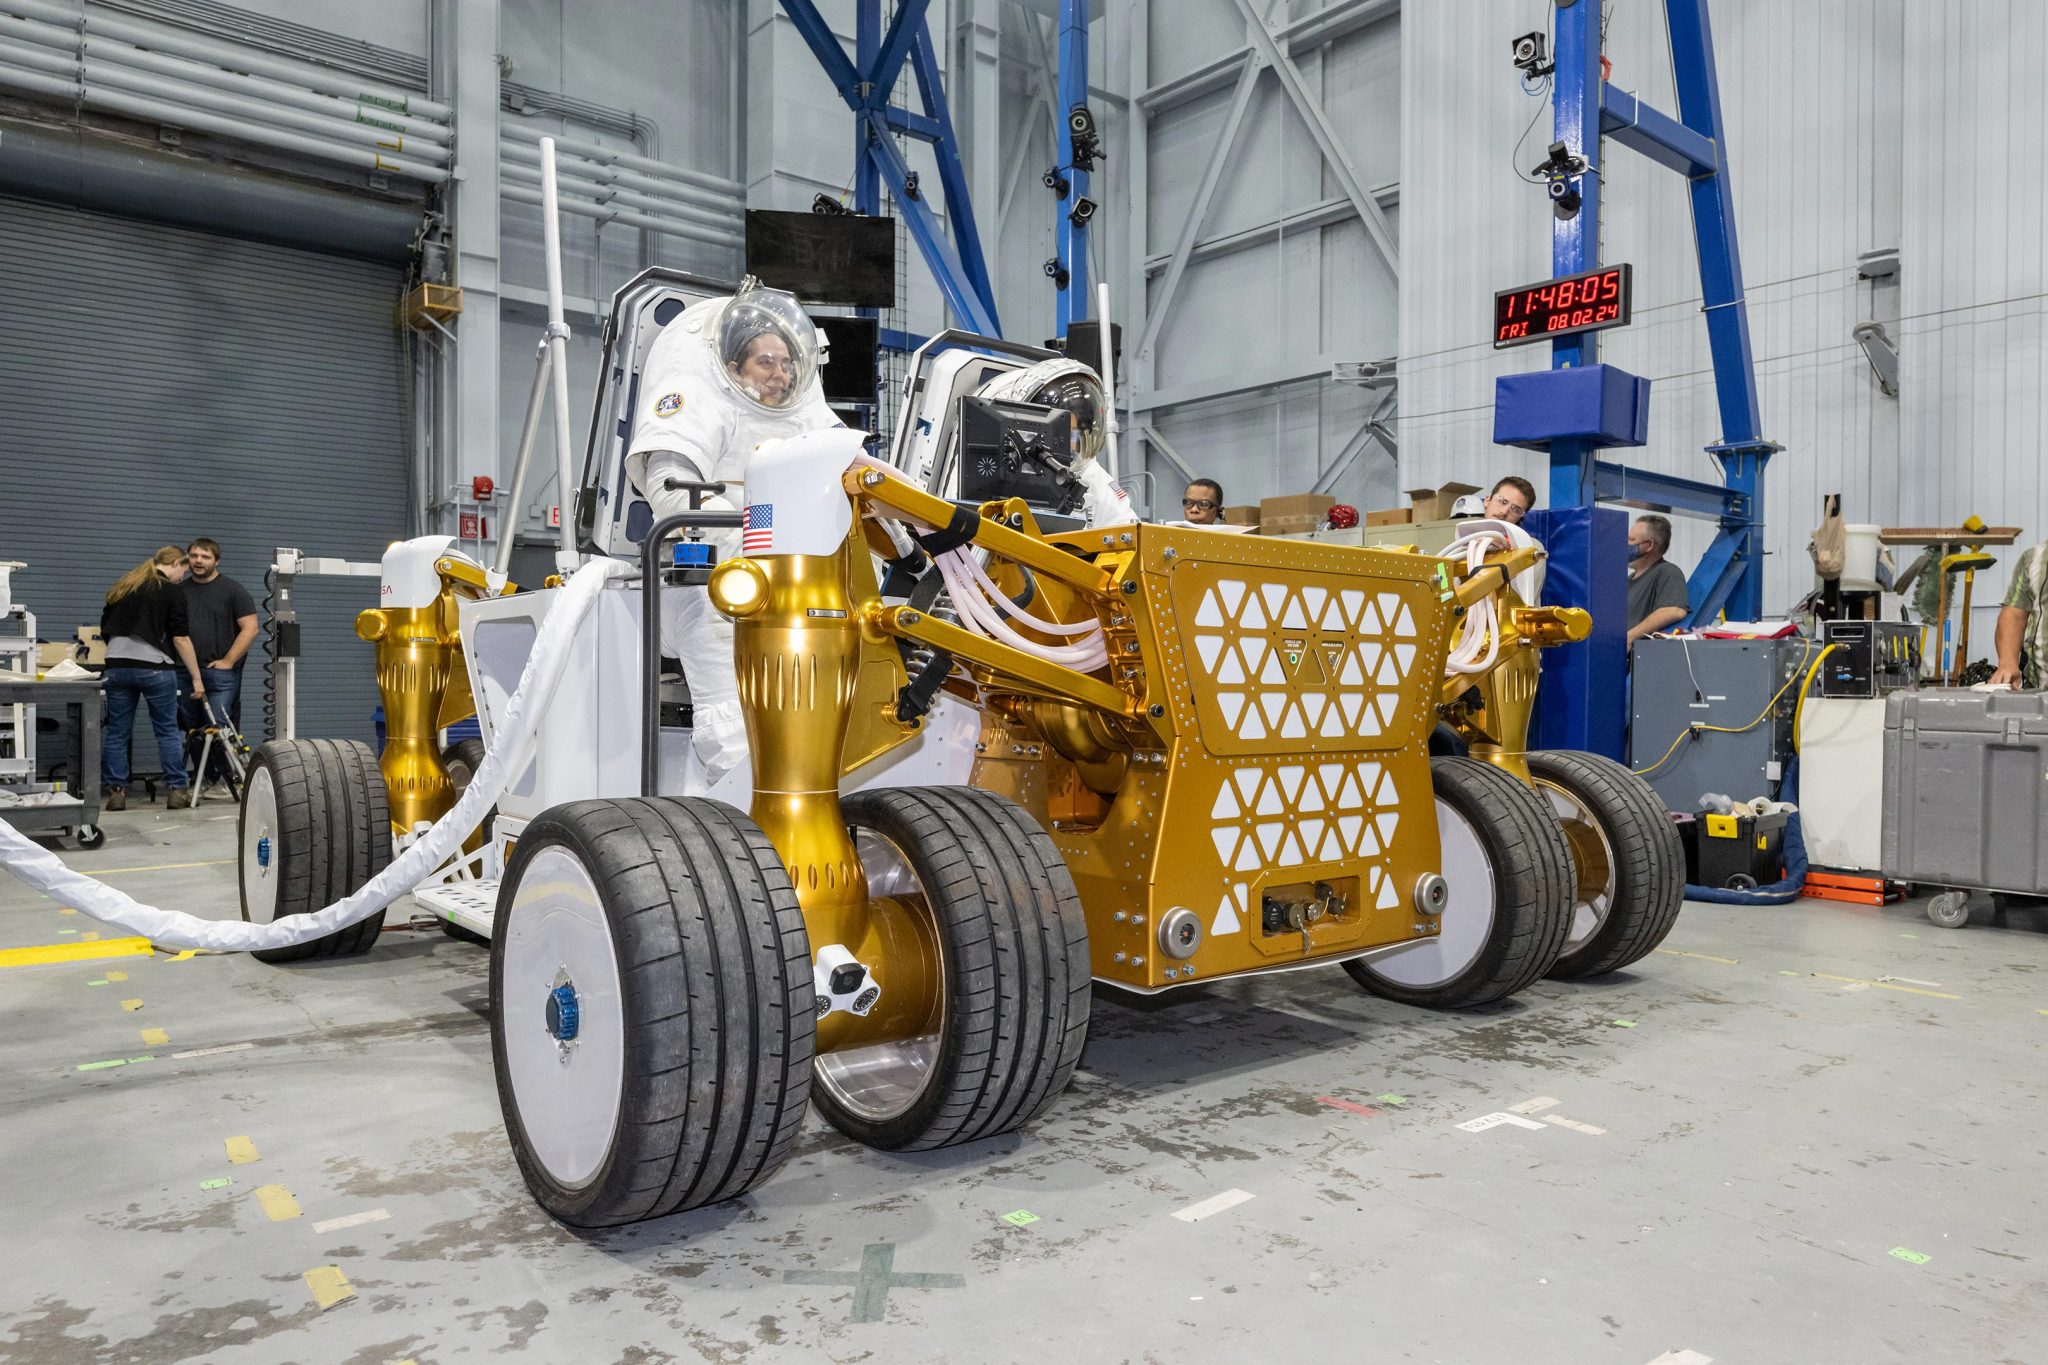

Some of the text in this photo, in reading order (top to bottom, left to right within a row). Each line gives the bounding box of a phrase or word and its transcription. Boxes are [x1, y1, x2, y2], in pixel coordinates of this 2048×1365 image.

[1508, 271, 1619, 318] 11:48:05
[1500, 304, 1618, 340] FRI 08.02.24
